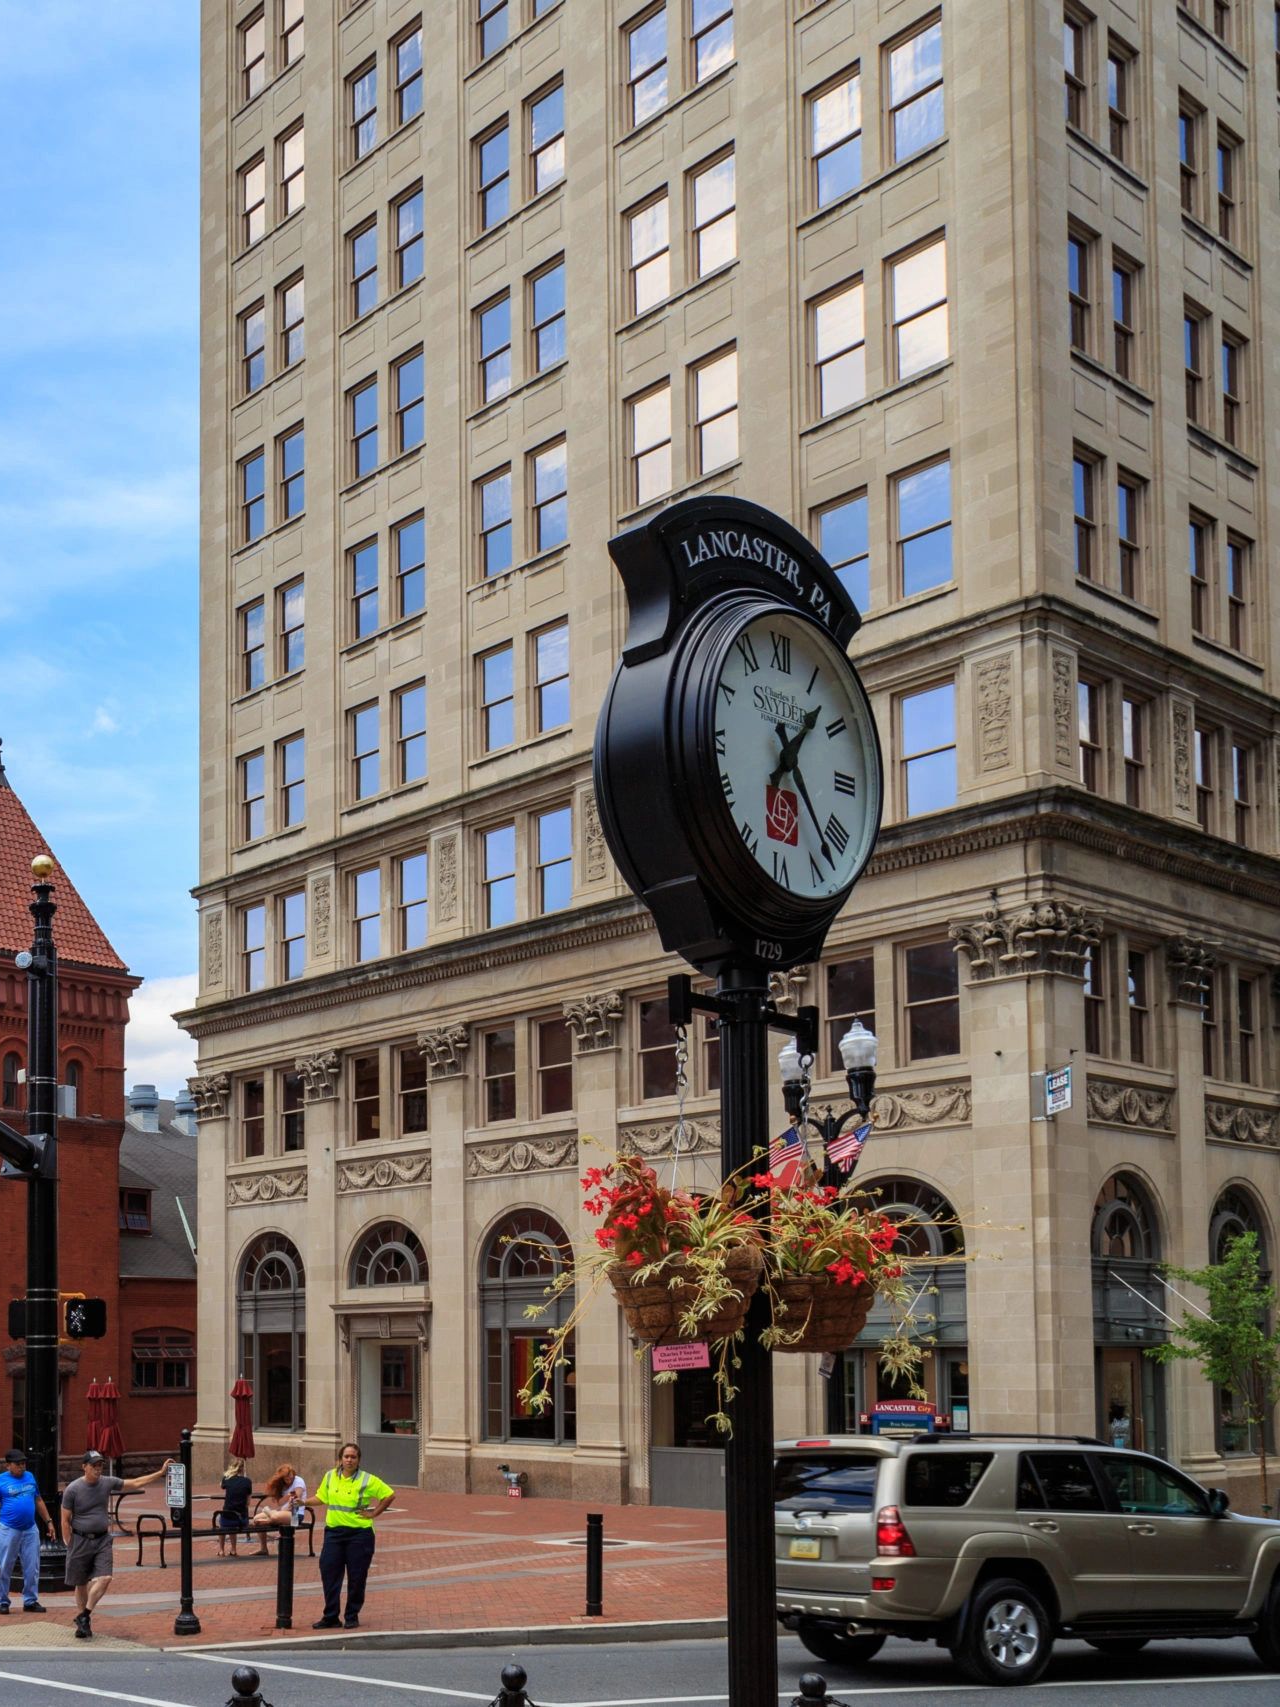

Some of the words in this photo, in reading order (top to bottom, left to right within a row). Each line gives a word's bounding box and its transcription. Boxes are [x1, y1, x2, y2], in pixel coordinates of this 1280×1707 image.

[681, 531, 803, 595] LANCASTER,
[808, 582, 832, 626] PA
[770, 631, 791, 675] XII
[755, 939, 782, 960] 1729
[1049, 1075, 1068, 1090] LEASE
[875, 1404, 916, 1412] LANCASTER
[917, 1404, 931, 1413] City
